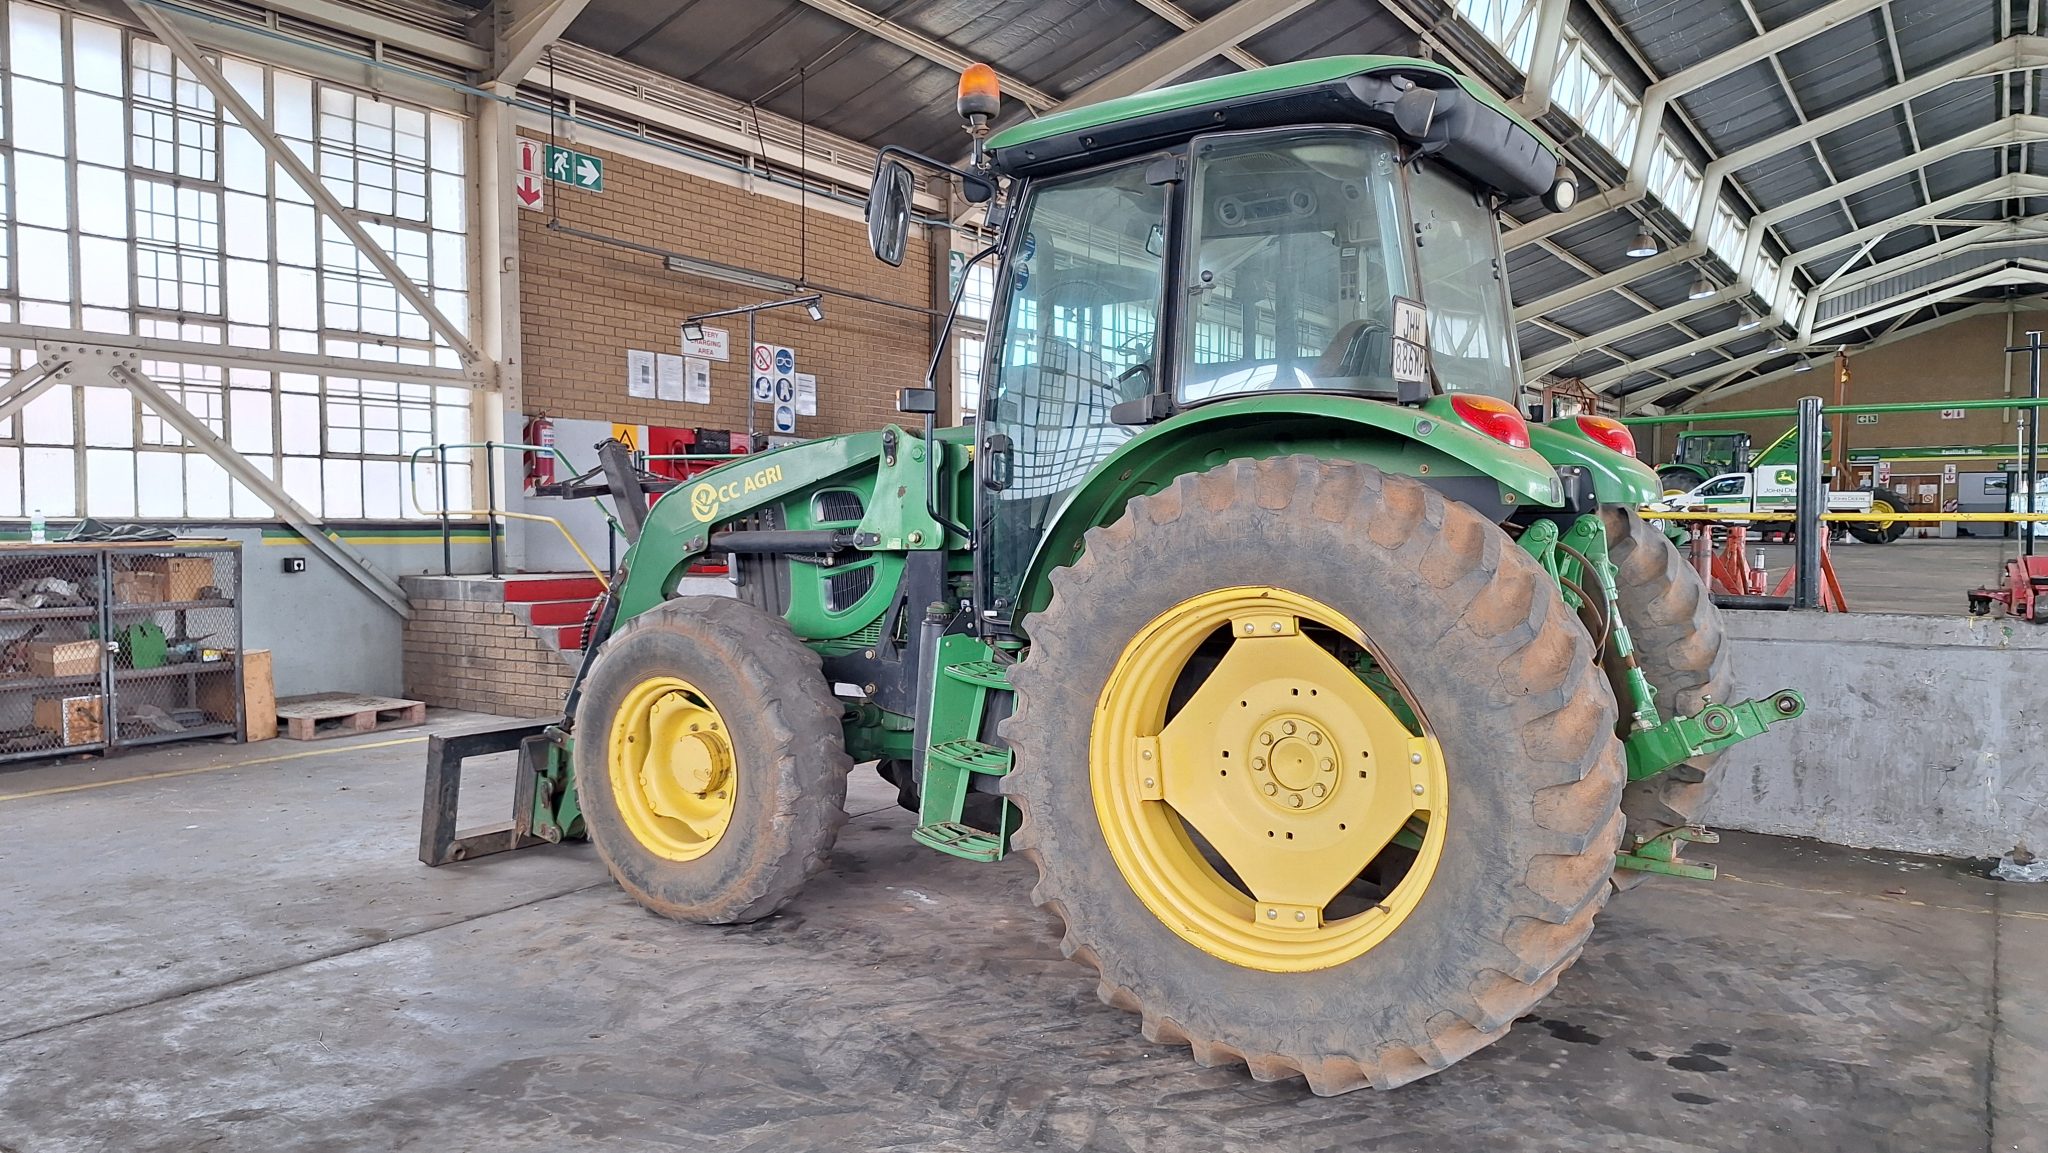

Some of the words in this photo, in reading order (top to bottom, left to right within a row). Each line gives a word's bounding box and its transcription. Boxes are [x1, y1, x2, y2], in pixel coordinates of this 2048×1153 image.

[1403, 309, 1421, 342] JHH
[697, 347, 714, 356] AREA
[718, 481, 741, 503] CC
[744, 464, 784, 495] AGRI
